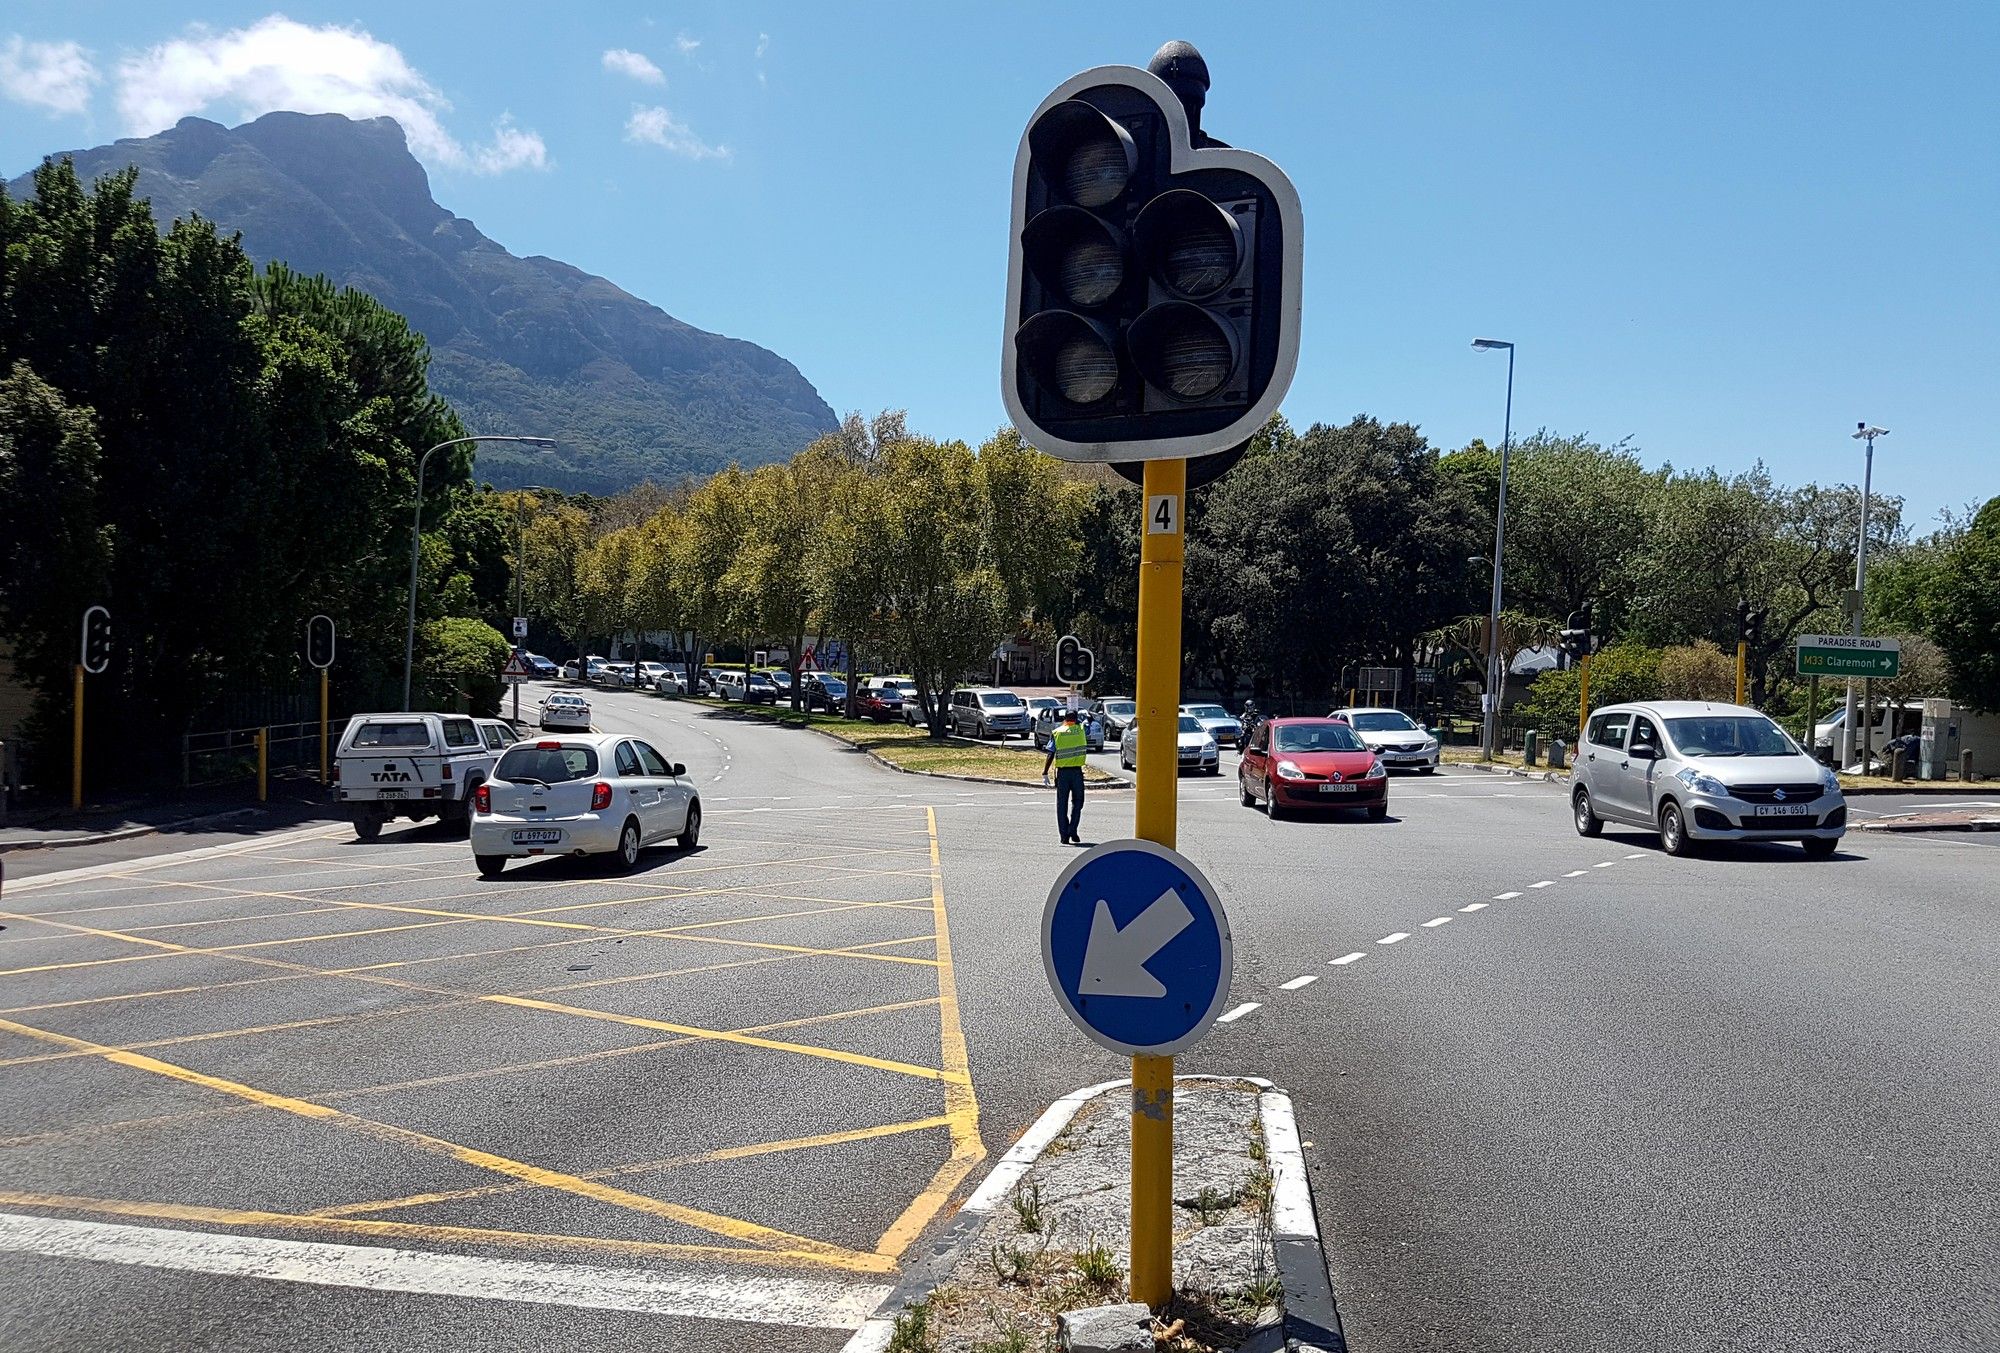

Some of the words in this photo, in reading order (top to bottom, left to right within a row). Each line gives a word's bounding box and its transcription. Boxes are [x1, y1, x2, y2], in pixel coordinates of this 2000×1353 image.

[1154, 498, 1171, 530] 4
[1818, 637, 1857, 647] PARADISE
[1859, 639, 1882, 648] ROAD
[1803, 655, 1823, 665] M33
[1826, 656, 1876, 668] Claremont
[370, 772, 412, 782] TATA
[1759, 806, 1769, 815] CY
[514, 831, 523, 840] CA
